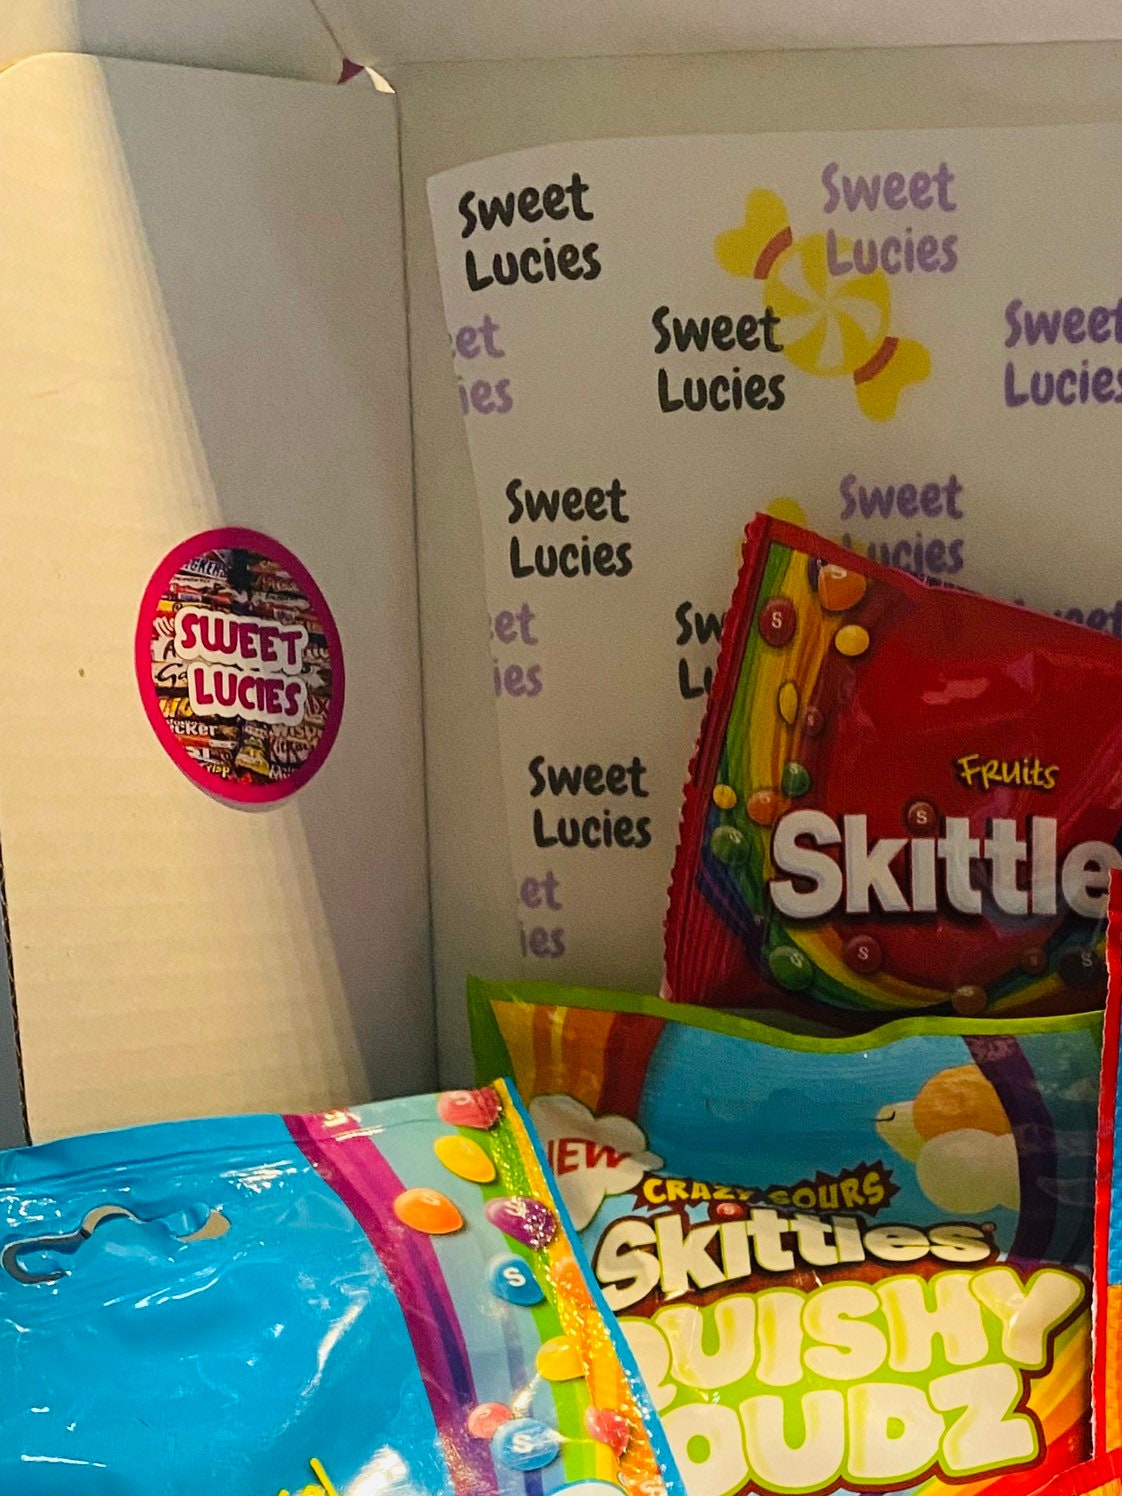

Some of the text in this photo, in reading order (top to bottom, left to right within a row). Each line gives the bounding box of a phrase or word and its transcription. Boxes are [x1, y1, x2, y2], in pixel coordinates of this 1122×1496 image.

[458, 173, 594, 238] Sweet
[821, 161, 958, 214] Sweet
[465, 237, 602, 292] Lucies
[826, 229, 959, 277] Lucies
[652, 306, 784, 354] Sweet
[657, 367, 786, 413] Lucies
[505, 478, 630, 524] Sweet
[839, 473, 964, 520] Sweet
[509, 535, 632, 579] Lucies
[181, 613, 303, 666] SWEET
[194, 667, 302, 717] LUCIES
[529, 755, 650, 797] Sweet
[957, 753, 1060, 791] Fruits
[533, 808, 652, 848] Lucies
[596, 1207, 993, 1313] Skittles
[616, 1266, 1086, 1416] UISHY
